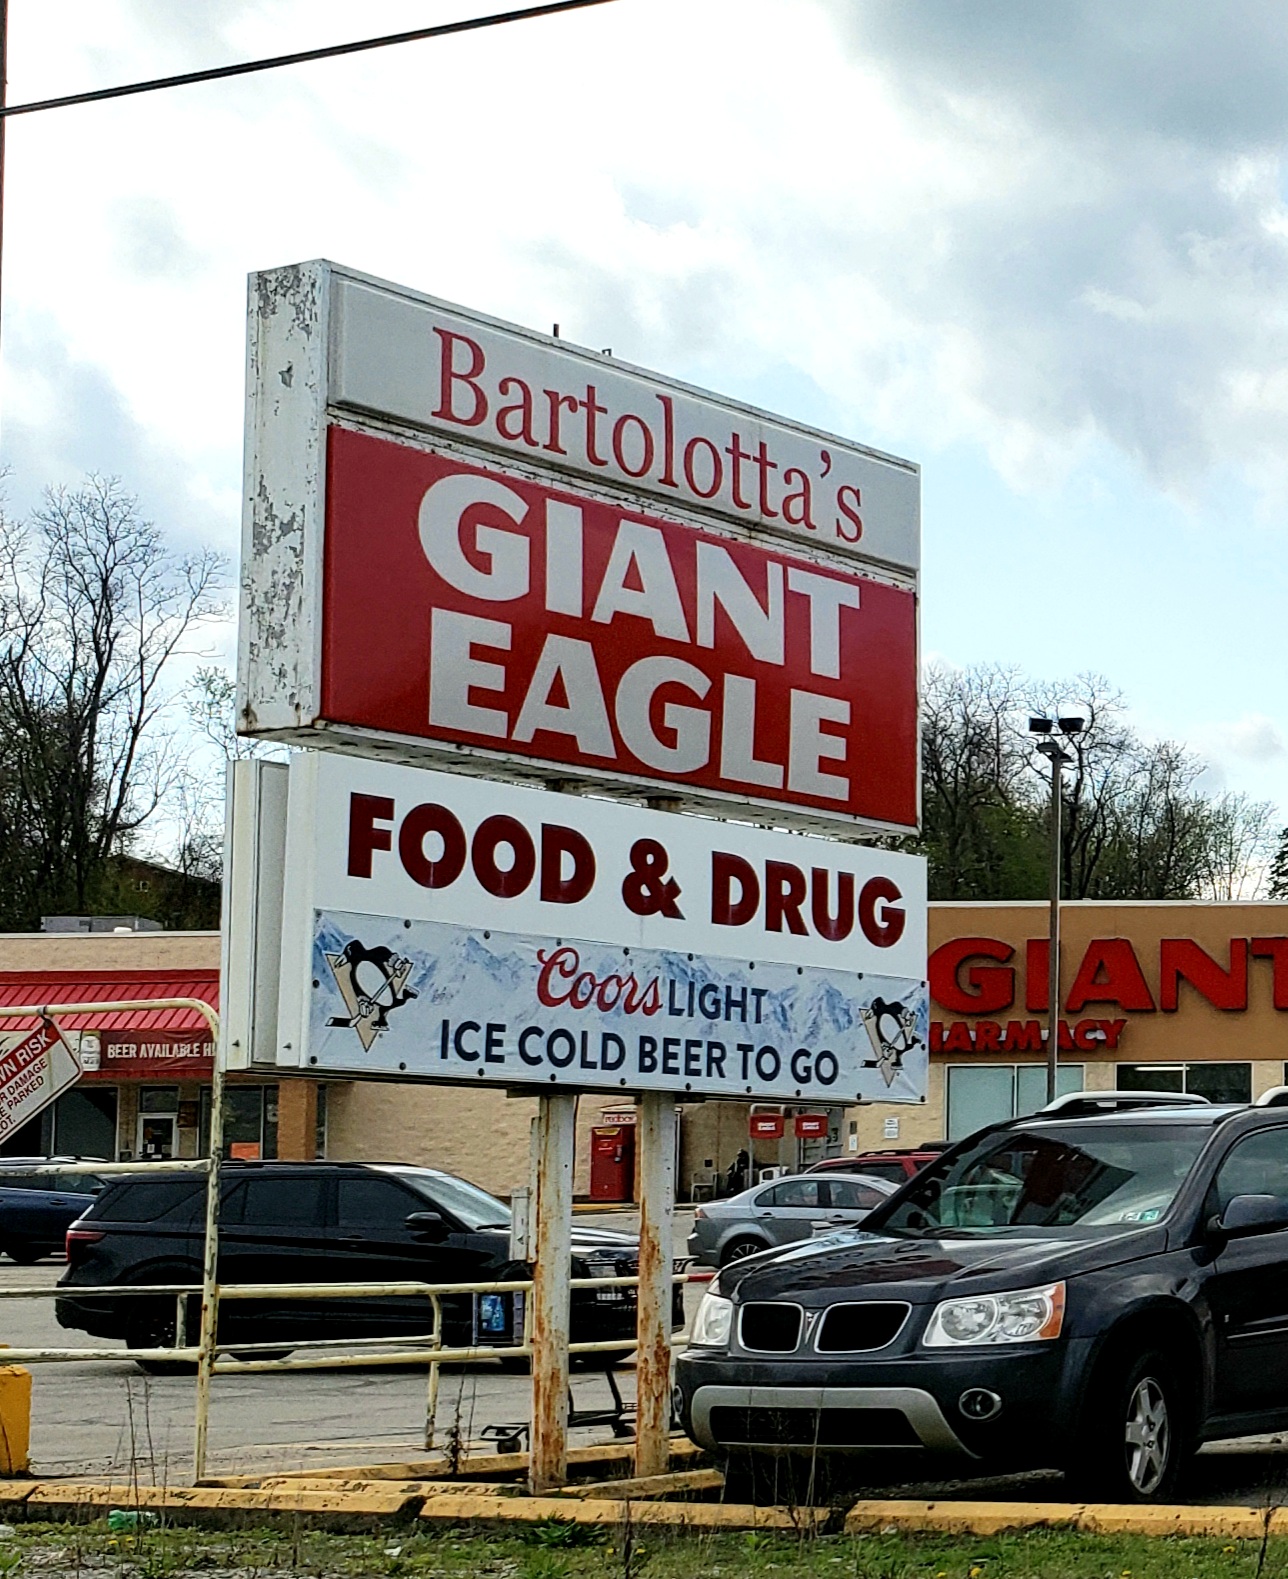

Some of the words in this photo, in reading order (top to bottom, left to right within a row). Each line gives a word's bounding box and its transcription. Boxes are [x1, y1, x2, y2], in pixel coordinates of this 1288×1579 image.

[431, 326, 863, 543] Bartolotta's
[418, 473, 860, 680] GIANT
[428, 606, 851, 802] EAGLE
[347, 791, 597, 905] FOOD
[621, 837, 686, 920] &
[710, 850, 907, 948] DRUG
[536, 946, 664, 1017] Coors
[668, 978, 768, 1025] LIGHT
[6, 1057, 49, 1096] DAMAGE
[15, 1029, 53, 1067] RISK
[107, 1043, 138, 1059] BEER
[140, 1043, 201, 1058] AVAILABLE
[440, 1018, 507, 1064] ICE
[517, 1025, 626, 1071] COLD
[638, 1034, 727, 1079] BEER
[736, 1042, 782, 1083] TO
[790, 1047, 840, 1086] GO
[6, 1075, 45, 1111] PARKED
